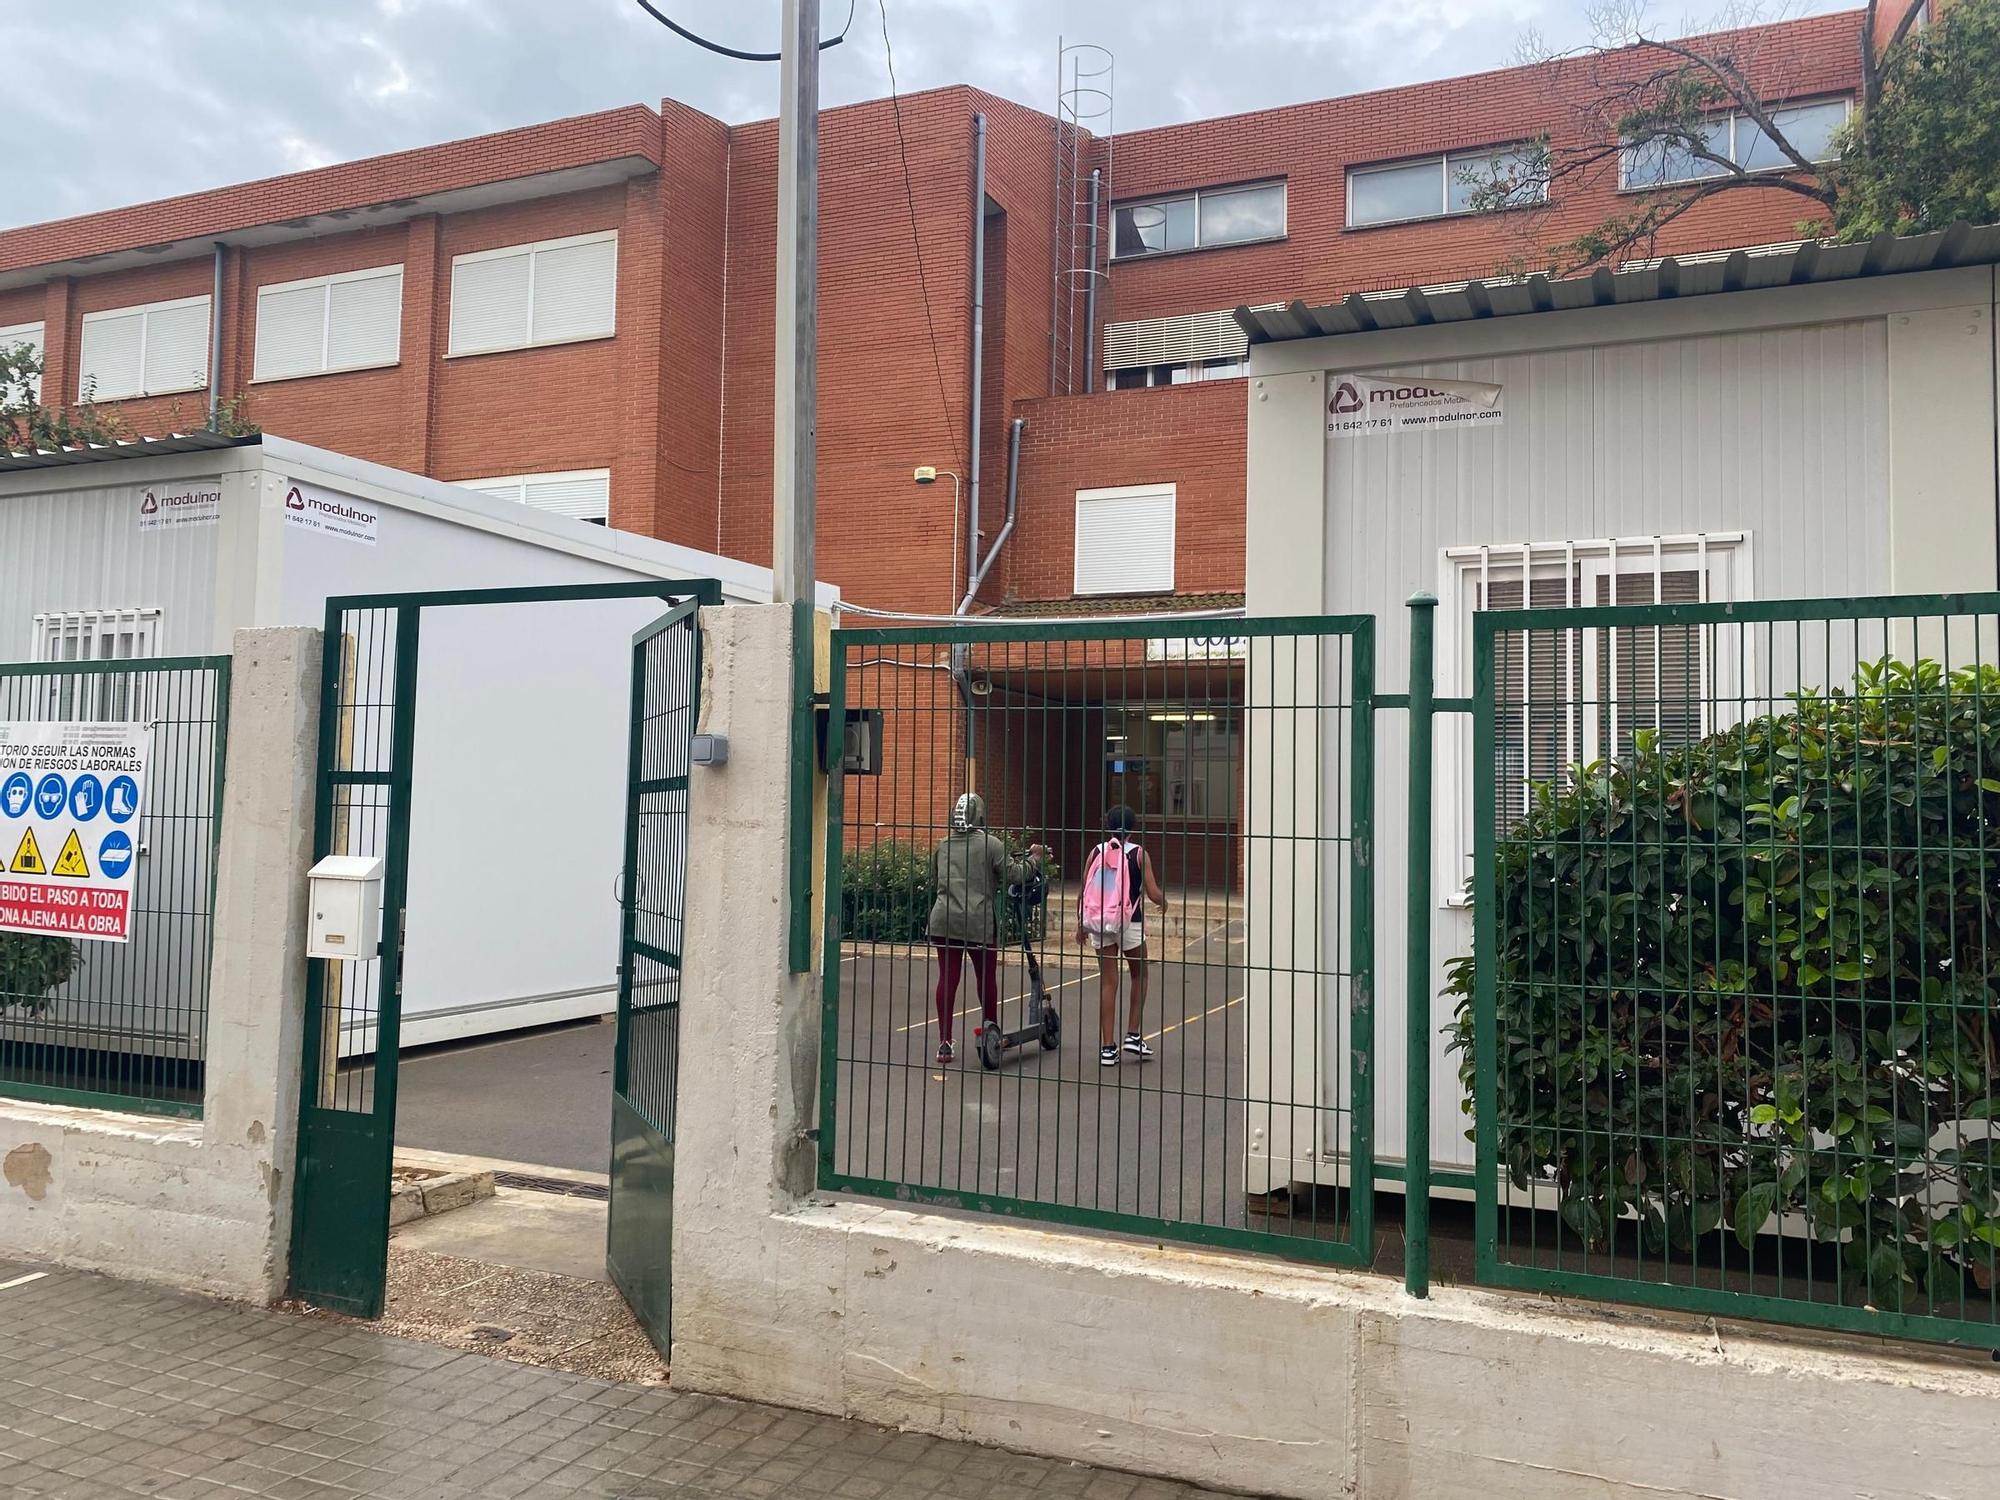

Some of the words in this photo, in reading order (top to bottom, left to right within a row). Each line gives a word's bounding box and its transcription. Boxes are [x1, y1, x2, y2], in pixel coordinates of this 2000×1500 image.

[1328, 423, 1340, 432] 91
[1343, 421, 1362, 430] 642
[1365, 419, 1377, 428] 17
[1380, 418, 1392, 427] 61
[1401, 410, 1502, 425] www.modulnor.com
[308, 498, 377, 524] modulnor
[0, 744, 29, 756] TORIO
[31, 745, 67, 757] SEGUIR
[69, 745, 89, 757] LAS
[91, 746, 136, 758] NORMAS
[18, 758, 32, 769] DE
[34, 758, 78, 770] RIESGOS
[80, 760, 142, 772] LABORALES
[30, 887, 44, 904] EL
[47, 888, 78, 906] PASO
[80, 891, 89, 907] A
[91, 891, 124, 910] TODA
[21, 909, 58, 928] AJENA
[59, 911, 68, 929] A
[70, 913, 86, 931] LA
[88, 914, 121, 934] OBRA
